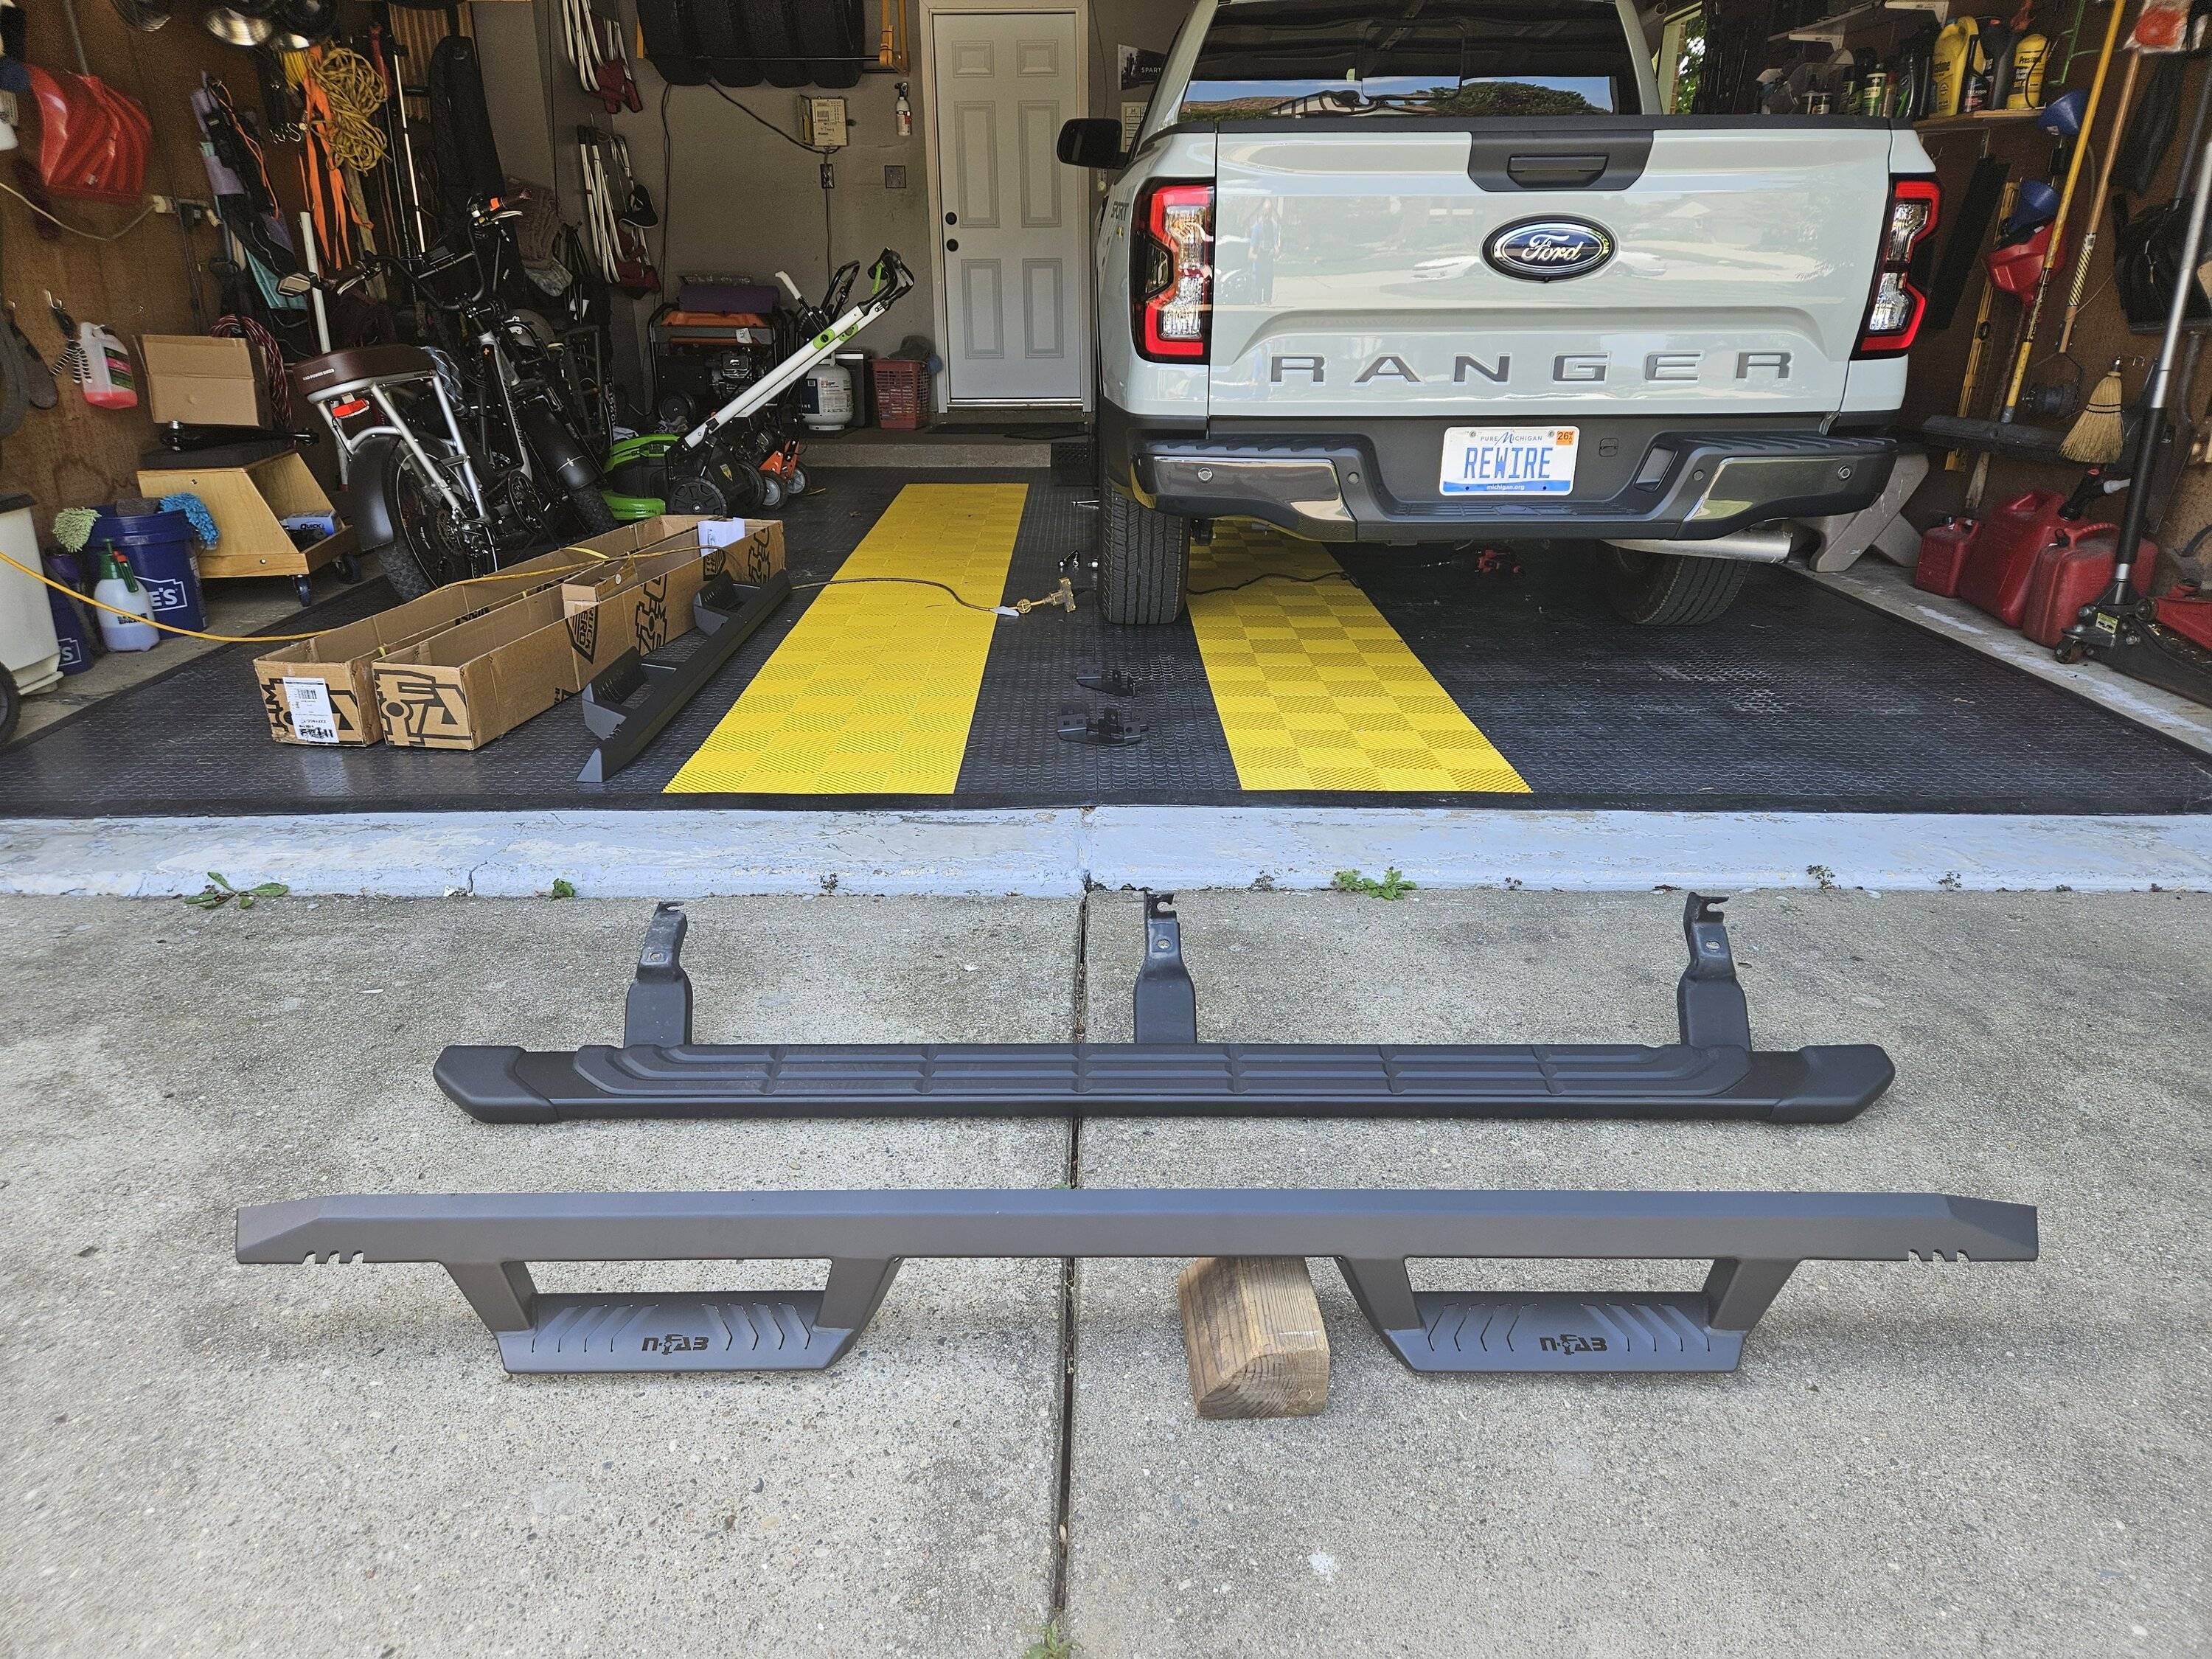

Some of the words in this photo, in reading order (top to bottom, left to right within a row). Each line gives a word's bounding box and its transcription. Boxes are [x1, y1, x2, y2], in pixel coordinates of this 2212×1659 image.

[1521, 234, 1585, 262] Ford
[1269, 350, 1793, 386] RANGER
[1494, 431, 1543, 446] MICHIGAN
[1557, 431, 1569, 440] 26
[1464, 447, 1554, 479] REWIRE
